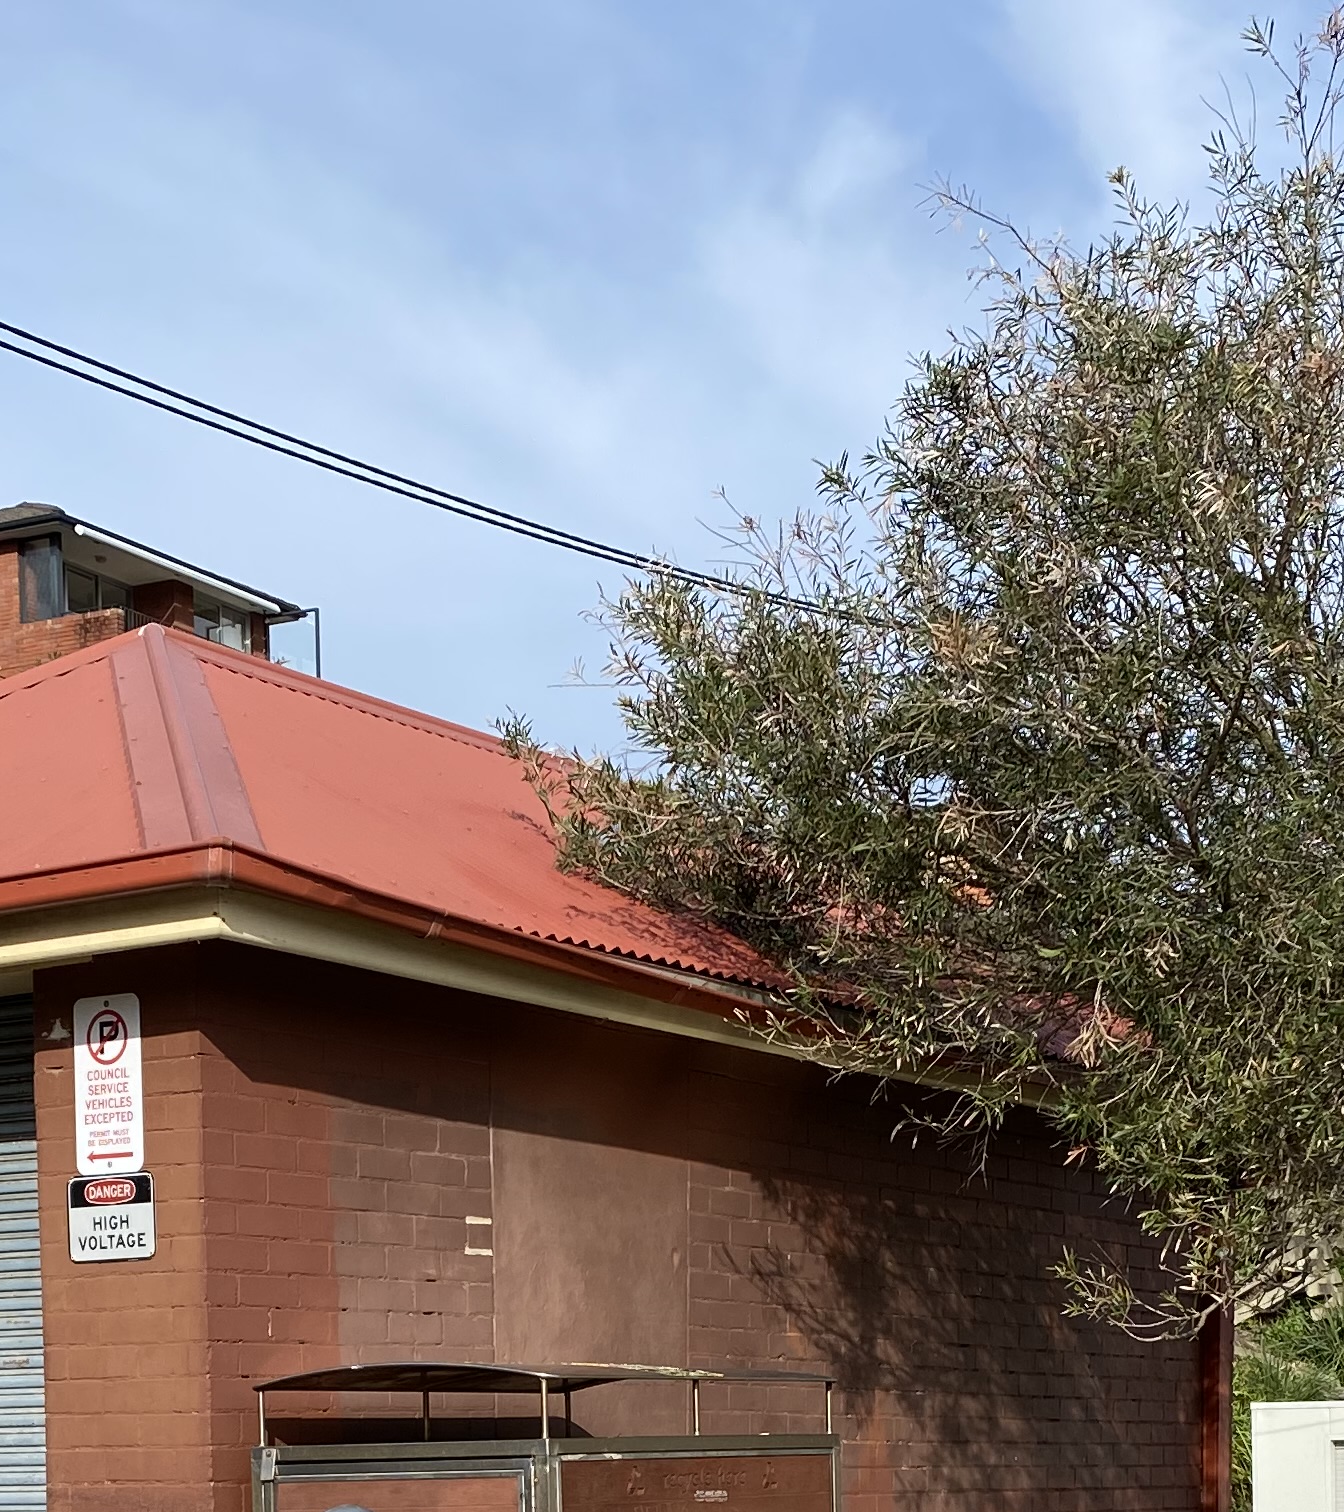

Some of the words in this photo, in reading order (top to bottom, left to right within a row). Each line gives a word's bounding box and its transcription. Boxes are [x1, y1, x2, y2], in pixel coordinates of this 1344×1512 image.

[86, 1067, 131, 1082] COUNCIL
[87, 1081, 129, 1096] SERVICE
[85, 1096, 133, 1111] VEHICLES
[84, 1110, 134, 1126] EXCEPTED
[88, 1183, 131, 1200] DANGER
[92, 1214, 130, 1232] HIGH
[78, 1232, 147, 1252] VOLTAGE
[663, 1466, 712, 1494] recycle
[717, 1464, 747, 1487] here
